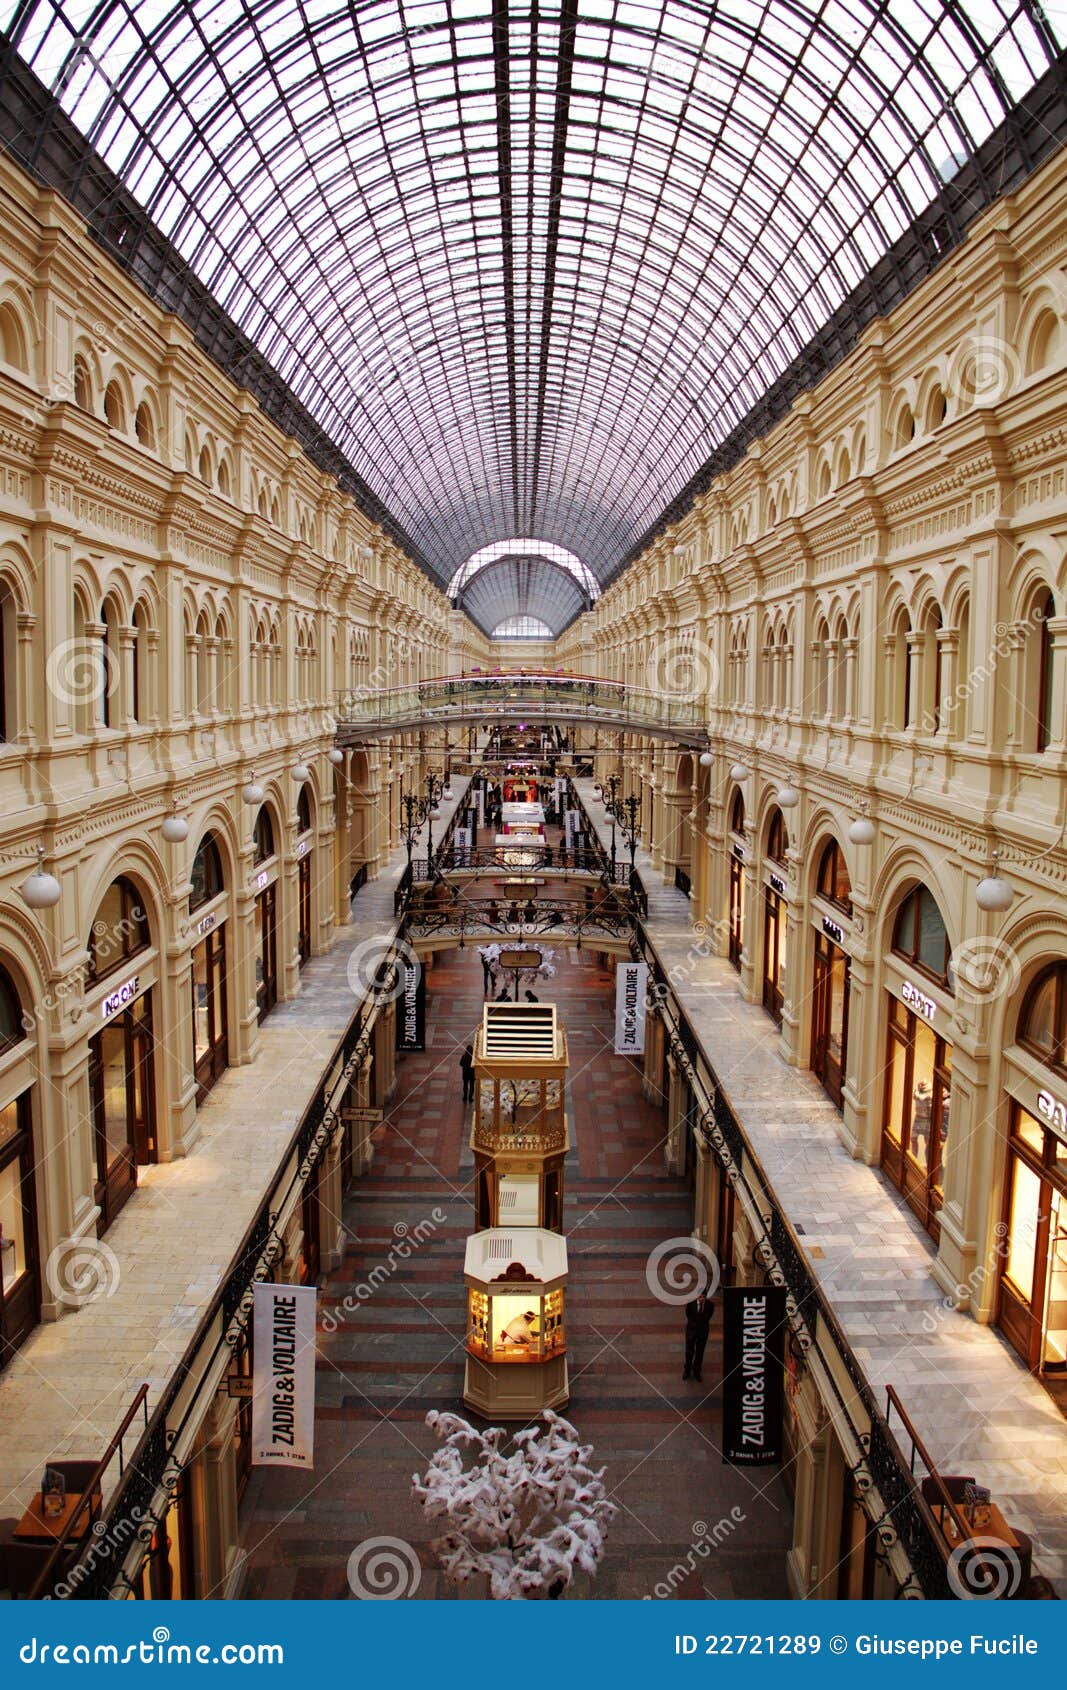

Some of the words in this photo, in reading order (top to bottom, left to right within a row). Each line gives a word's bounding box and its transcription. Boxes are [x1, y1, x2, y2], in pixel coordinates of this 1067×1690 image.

[102, 992, 120, 1019] NO
[1037, 1089, 1067, 1133] GA
[272, 1295, 297, 1447] ZADIG&VOLTAIRE
[742, 1296, 766, 1446] ZADIG&VOLTAIRE
